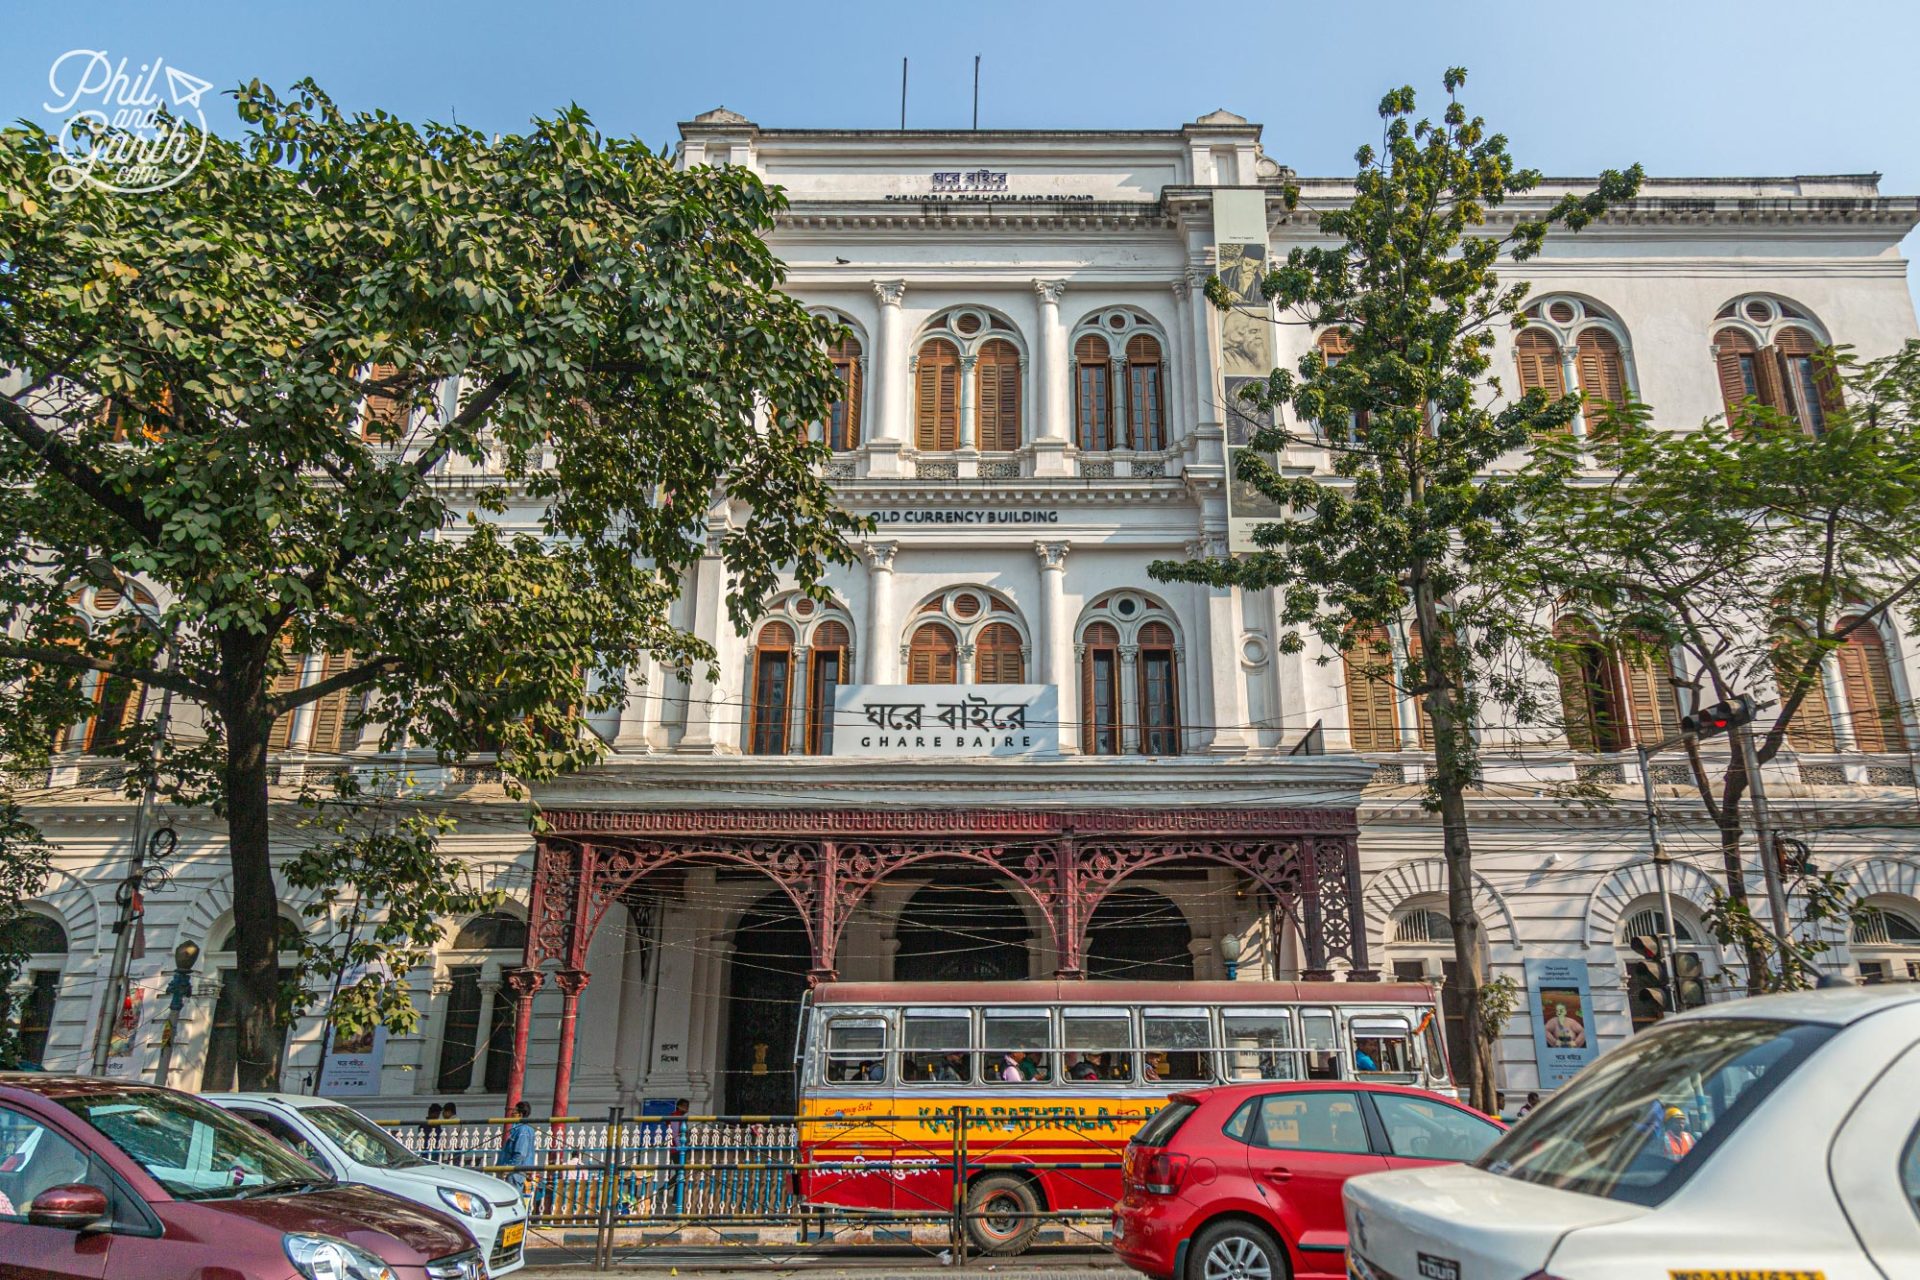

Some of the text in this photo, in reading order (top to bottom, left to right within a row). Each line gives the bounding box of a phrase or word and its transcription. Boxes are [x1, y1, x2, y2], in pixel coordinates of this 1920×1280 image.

[934, 169, 1008, 184] ঘরে বাইরে
[870, 511, 1058, 523] OLD CURRENCY BUILDING
[863, 693, 1029, 732] ঘরে বাইরে
[861, 736, 1031, 747] GHARE BAIRE
